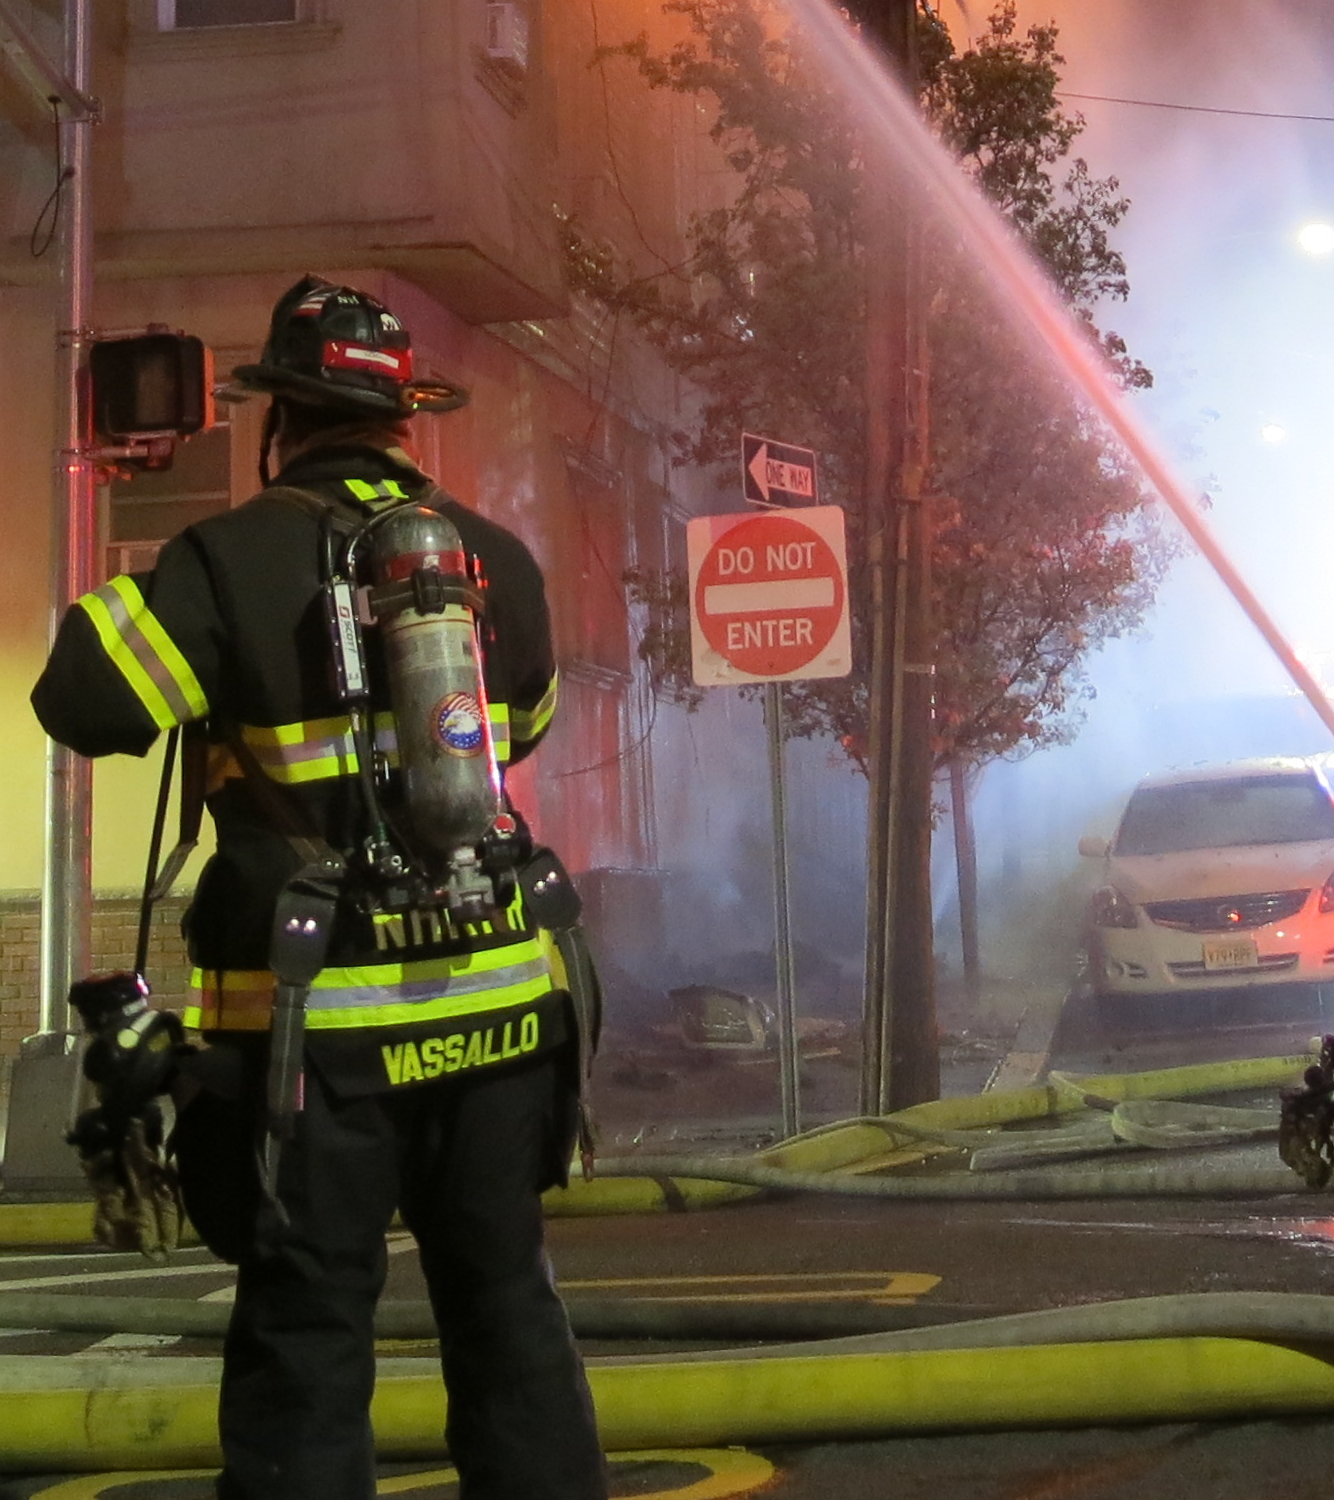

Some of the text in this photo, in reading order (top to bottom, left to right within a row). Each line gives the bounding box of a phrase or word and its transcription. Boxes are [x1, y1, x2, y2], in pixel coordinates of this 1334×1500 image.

[767, 461, 811, 493] ONE WAY
[718, 541, 816, 576] DO NOT
[727, 617, 813, 650] ENTER
[382, 1012, 539, 1086] VASSALLO
